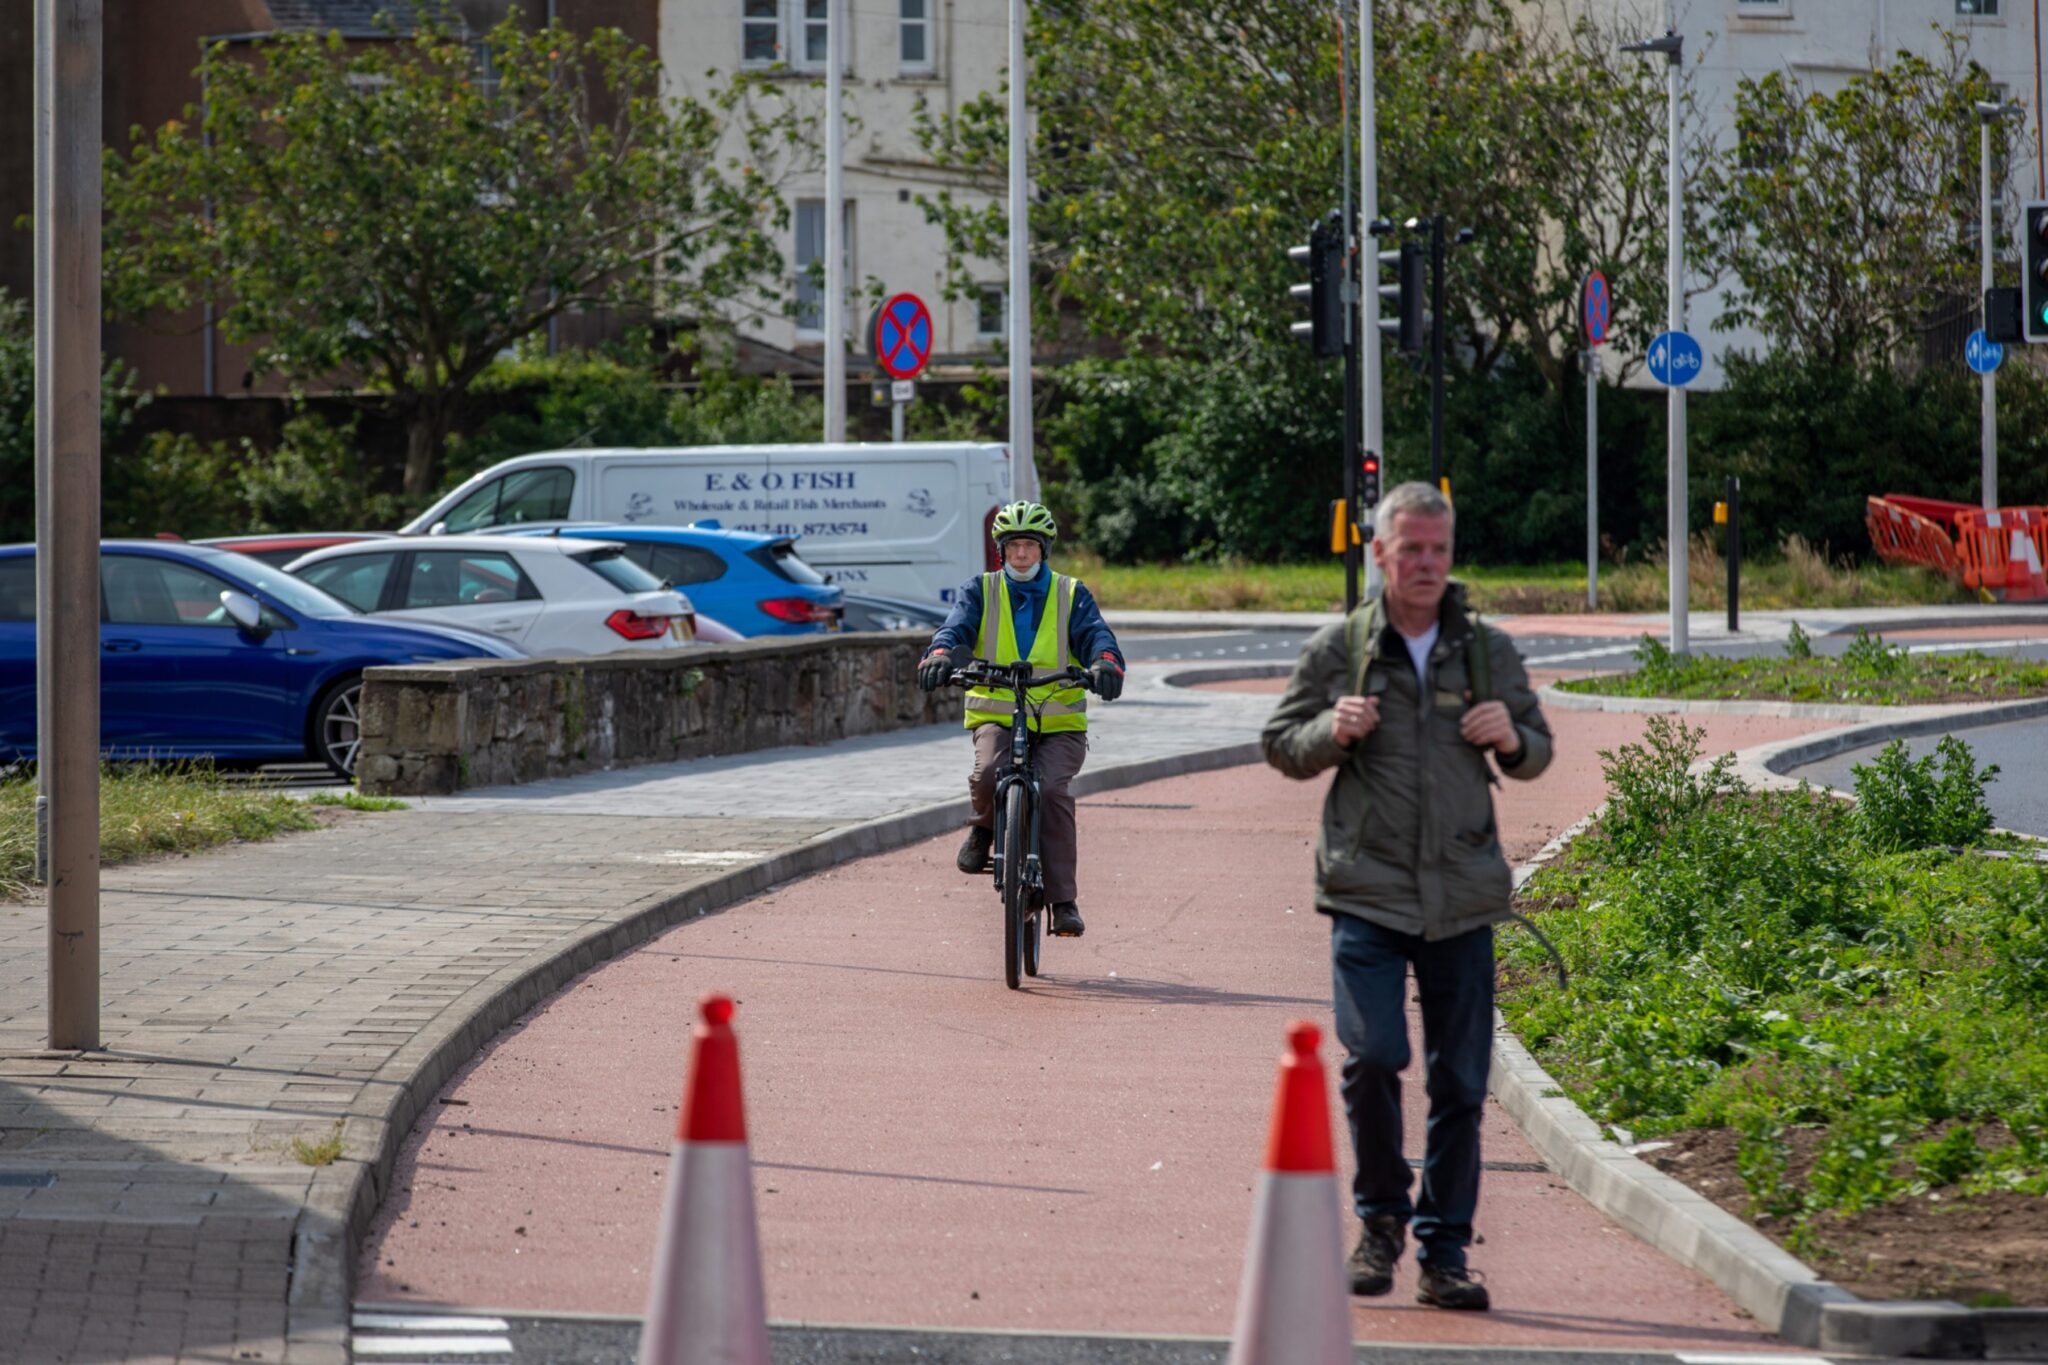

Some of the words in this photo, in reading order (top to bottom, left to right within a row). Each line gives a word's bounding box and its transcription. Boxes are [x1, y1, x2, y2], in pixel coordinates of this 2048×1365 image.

[731, 472, 753, 491] &
[792, 471, 856, 490] FISH
[674, 500, 734, 511] Wholesale
[739, 501, 749, 511] &
[754, 500, 789, 511] Retail
[793, 499, 818, 510] Fish
[822, 498, 886, 510] Merchants
[803, 522, 868, 536] 873574
